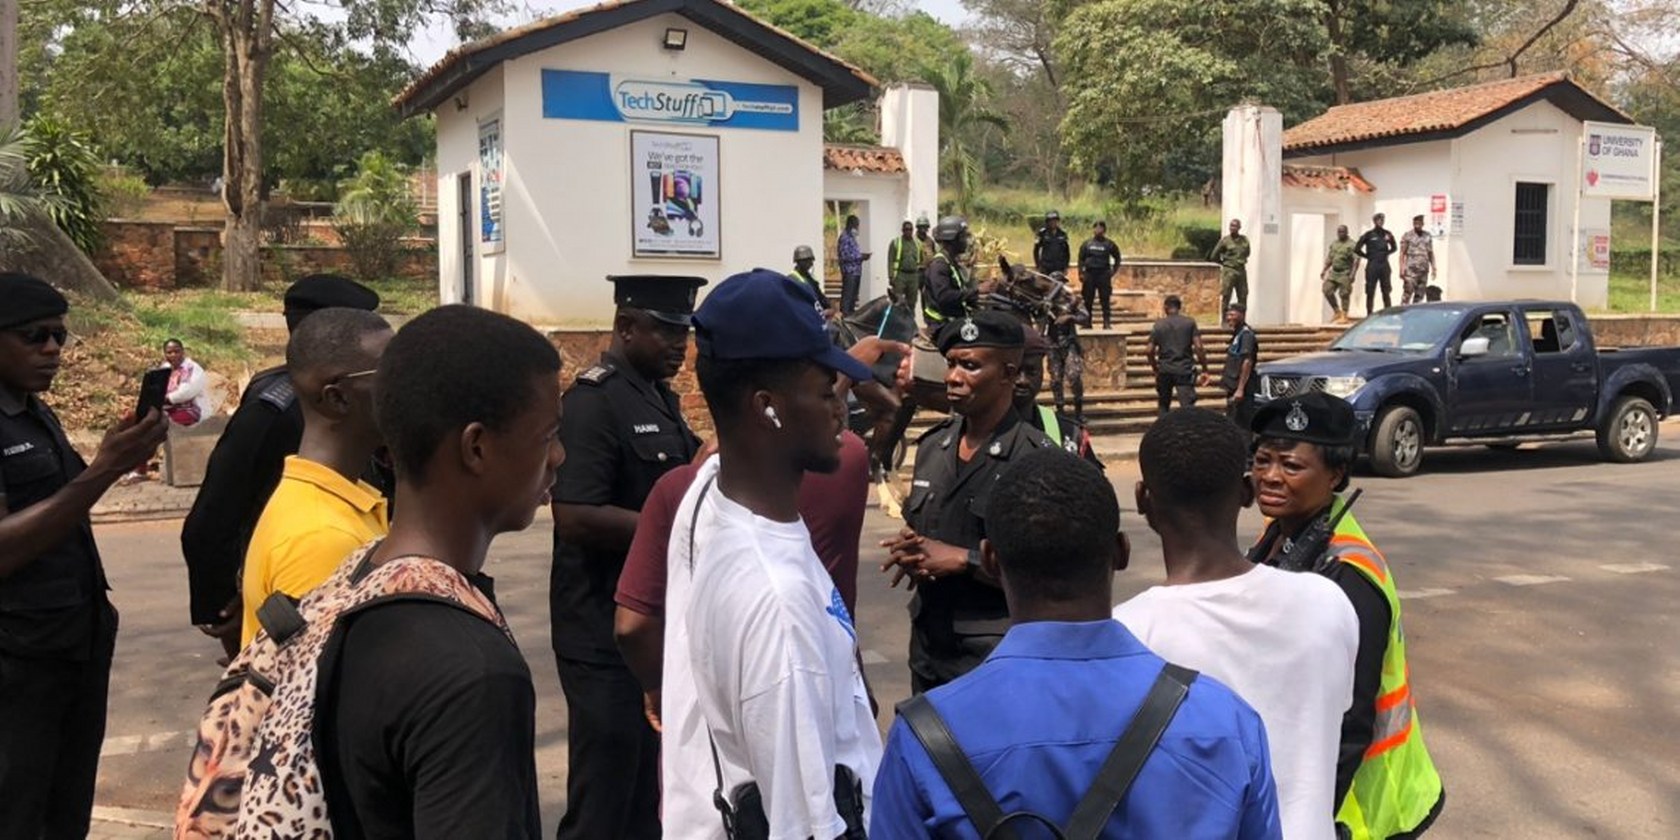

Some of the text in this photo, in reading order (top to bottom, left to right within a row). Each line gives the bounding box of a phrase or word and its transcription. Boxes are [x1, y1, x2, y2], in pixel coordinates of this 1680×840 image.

[619, 90, 699, 117] TechStuff
[1602, 134, 1643, 148] UNIVERSITY
[648, 151, 704, 164] We've got the
[1602, 146, 1639, 157] OF GHANA
